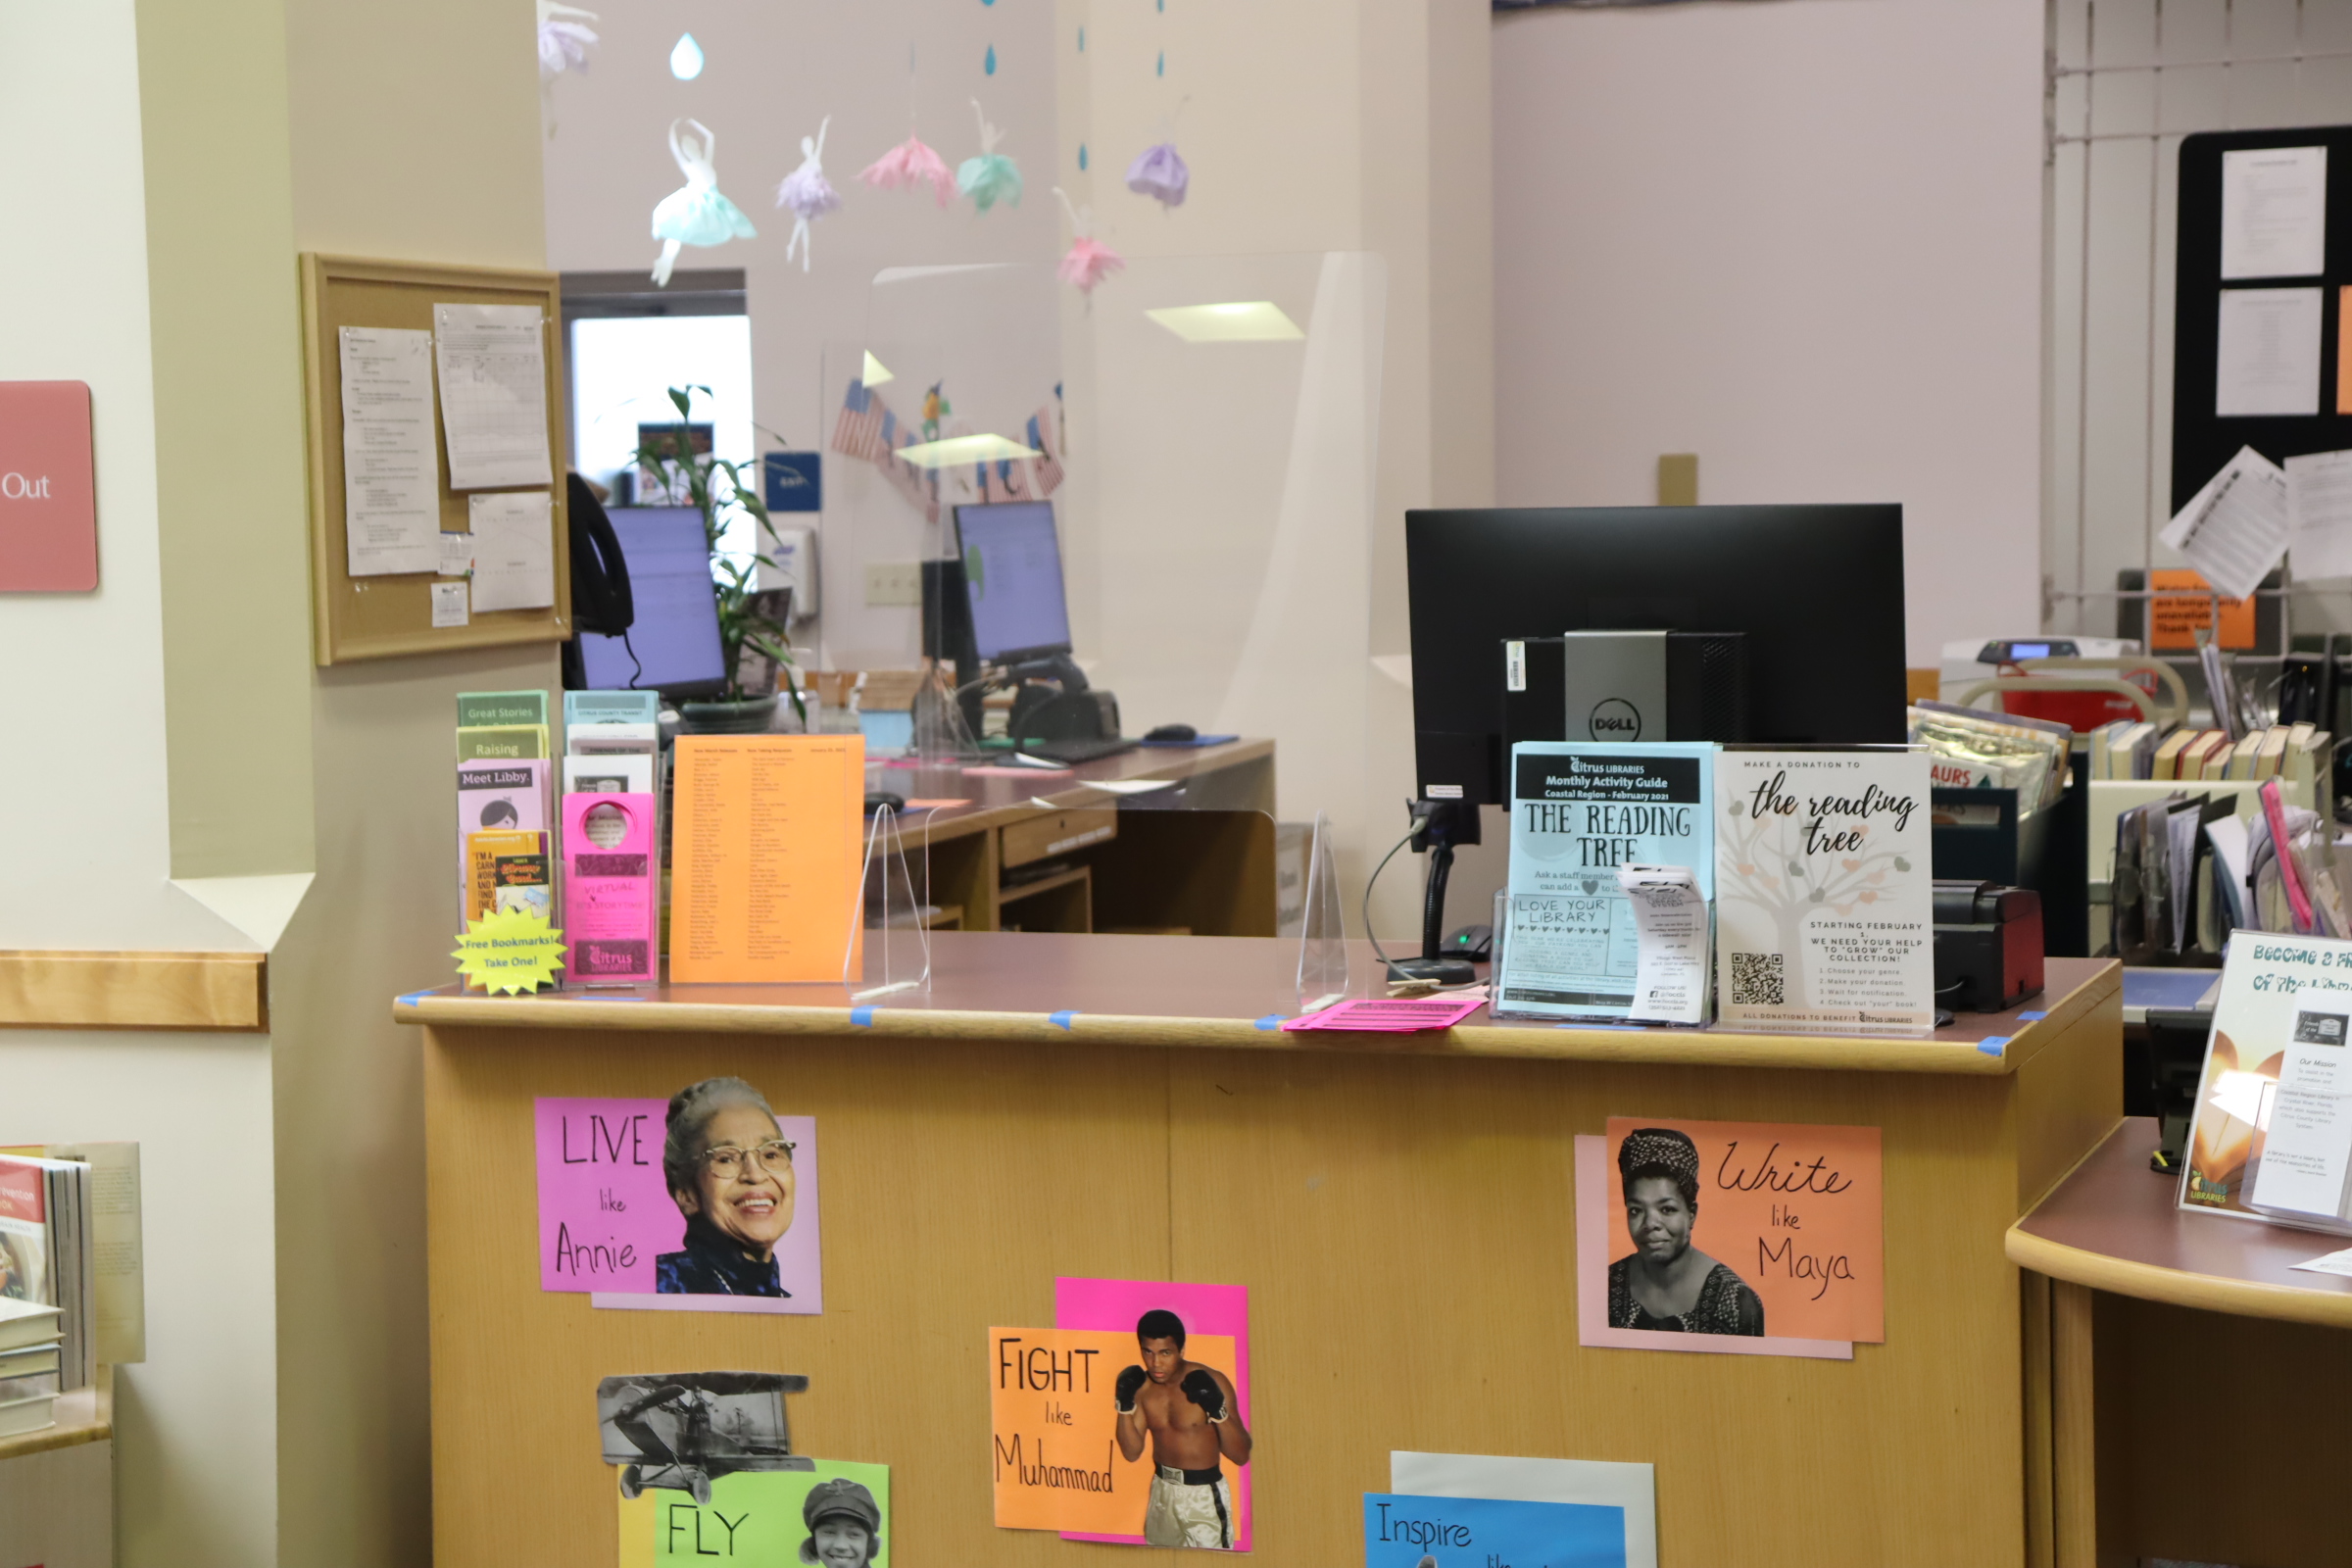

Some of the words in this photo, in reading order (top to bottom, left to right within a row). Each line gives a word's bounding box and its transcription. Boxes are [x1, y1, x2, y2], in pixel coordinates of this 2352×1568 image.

[2, 471, 51, 499] Out
[468, 709, 496, 718] Great
[499, 707, 533, 717] Stories
[1595, 718, 1636, 732] DELL
[476, 743, 519, 757] Raising
[1570, 759, 1604, 773] Citrus
[1605, 765, 1644, 774] LIBRARIES
[463, 773, 492, 784] Meet
[494, 771, 530, 784] Libby.
[1545, 775, 1591, 788] Monthly
[1592, 776, 1634, 790] Activity
[1636, 777, 1668, 788] Guide
[1931, 764, 1972, 788] AURS
[1544, 790, 1576, 799] Coastal
[1577, 790, 1606, 800] Region
[1612, 791, 1649, 802] February
[1749, 769, 1799, 819] the
[1809, 784, 1920, 832] reading
[1524, 804, 1572, 833] THE
[1586, 806, 1690, 837] READING
[1804, 816, 1864, 856] tree
[1576, 838, 1638, 867] TREE
[1560, 871, 1580, 880] staff
[584, 881, 635, 894] VIRTUAL
[1519, 900, 1559, 911] LOVE
[1567, 899, 1606, 910] YOUR
[466, 940, 489, 949] Free
[491, 935, 555, 948] Bookmarks!
[484, 958, 509, 968] Take
[511, 956, 538, 967] One!
[589, 947, 633, 965] Citrus
[1859, 1012, 1884, 1023] Citrus
[2313, 1059, 2337, 1068] Mission
[563, 1114, 649, 1165] LIVE
[1718, 1141, 1852, 1194] Write
[0, 1187, 35, 1201] evention
[599, 1187, 626, 1212] like
[2190, 1190, 2227, 1203] LIBRARIES
[1771, 1203, 1801, 1230] like
[557, 1221, 637, 1277] Annie
[1758, 1236, 1855, 1301] Maya
[999, 1337, 1100, 1394] FIGHT
[1045, 1400, 1074, 1426] like
[995, 1433, 1114, 1494] Muhammad
[668, 1503, 750, 1556] FLY
[1376, 1503, 1472, 1553] Inspire
[1487, 1553, 1511, 1568] lik
